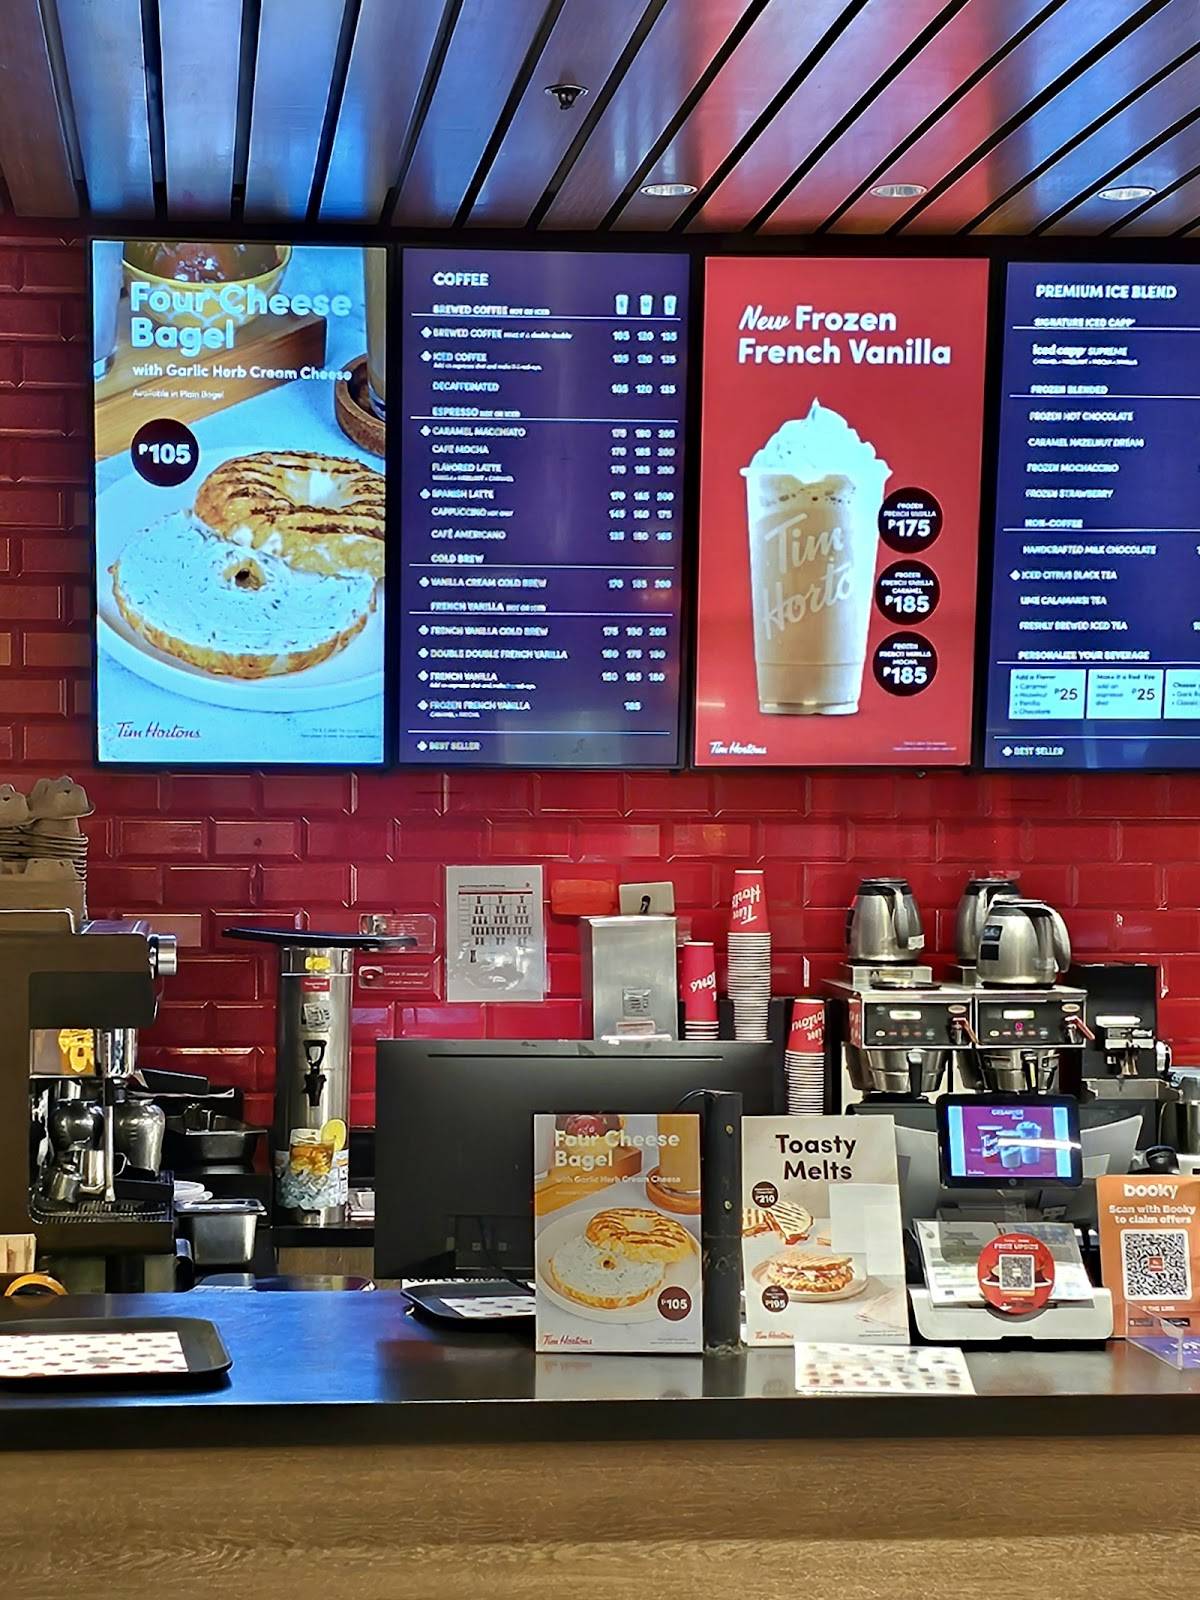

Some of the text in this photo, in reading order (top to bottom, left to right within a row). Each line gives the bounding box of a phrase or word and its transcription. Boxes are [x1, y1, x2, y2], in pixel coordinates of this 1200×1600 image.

[433, 272, 489, 286] COFFEE
[130, 281, 352, 316] Four Cheese
[1036, 284, 1177, 299] PREMIUM ICE BLEND
[738, 305, 897, 331] New Frozen
[130, 317, 234, 357] Bagel
[738, 337, 951, 364] French Vanilla
[133, 364, 352, 381] with Garlic Herb Cream Cheese
[764, 513, 844, 575] Tim
[117, 721, 201, 738] Tim Hortons
[710, 741, 767, 755] Tim Hortons
[555, 1129, 680, 1147] Four Cheese
[775, 1134, 857, 1159] Toasty
[555, 1150, 613, 1171] Bagel
[783, 1159, 853, 1180] Melts
[651, 1175, 681, 1184] Cheese
[1124, 1184, 1178, 1199] booky
[1109, 1204, 1196, 1216] Scan with Booky
[1115, 1215, 1192, 1224] to claim offers
[543, 1334, 592, 1346] Tim Hortons
